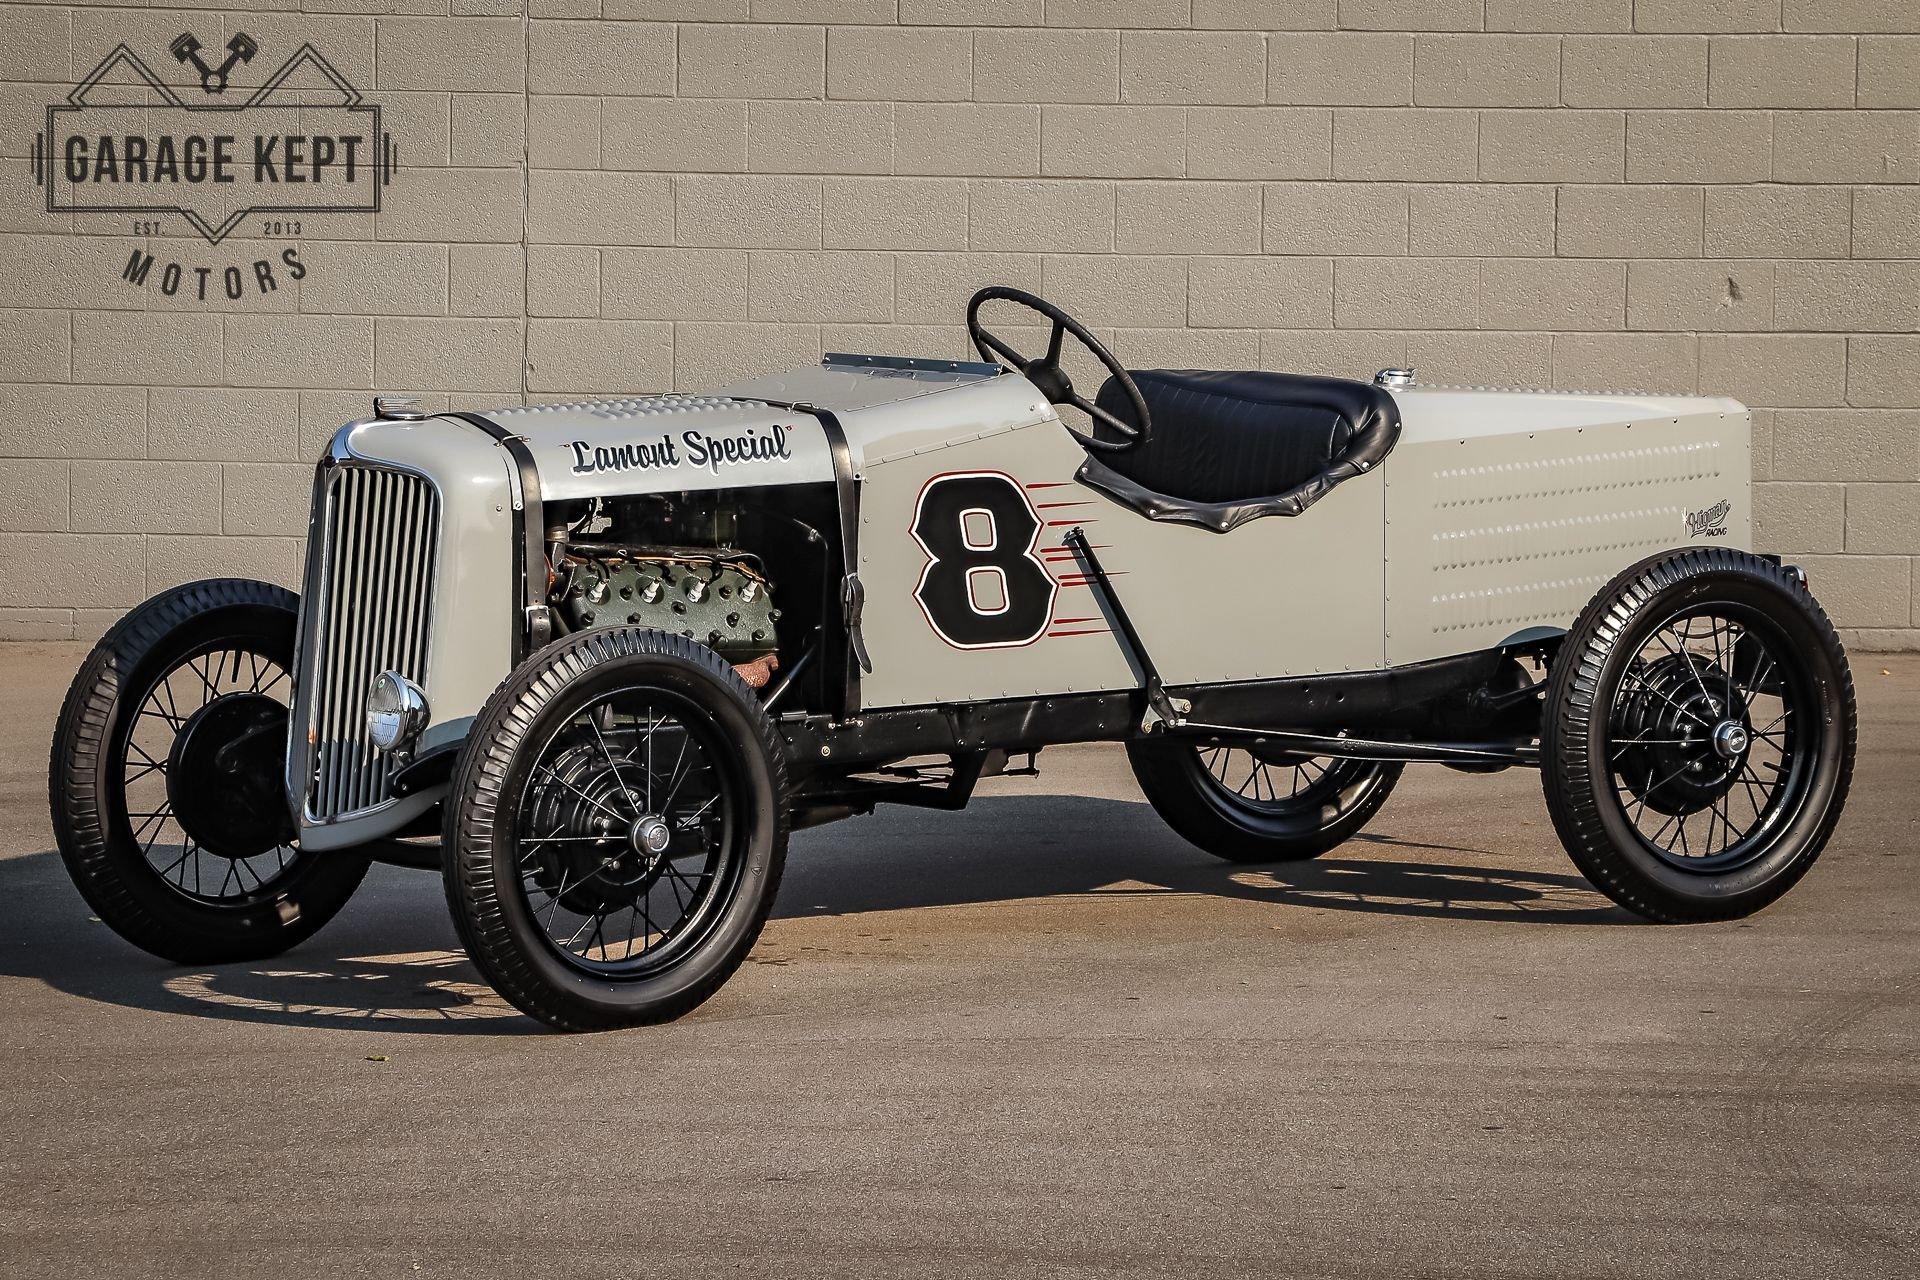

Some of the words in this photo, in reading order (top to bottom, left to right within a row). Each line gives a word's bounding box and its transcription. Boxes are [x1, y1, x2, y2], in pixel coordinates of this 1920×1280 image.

[571, 433, 681, 476] Lamont
[681, 424, 791, 476] Special
[1705, 527, 1728, 537] RACING
[908, 470, 1059, 651] 8
